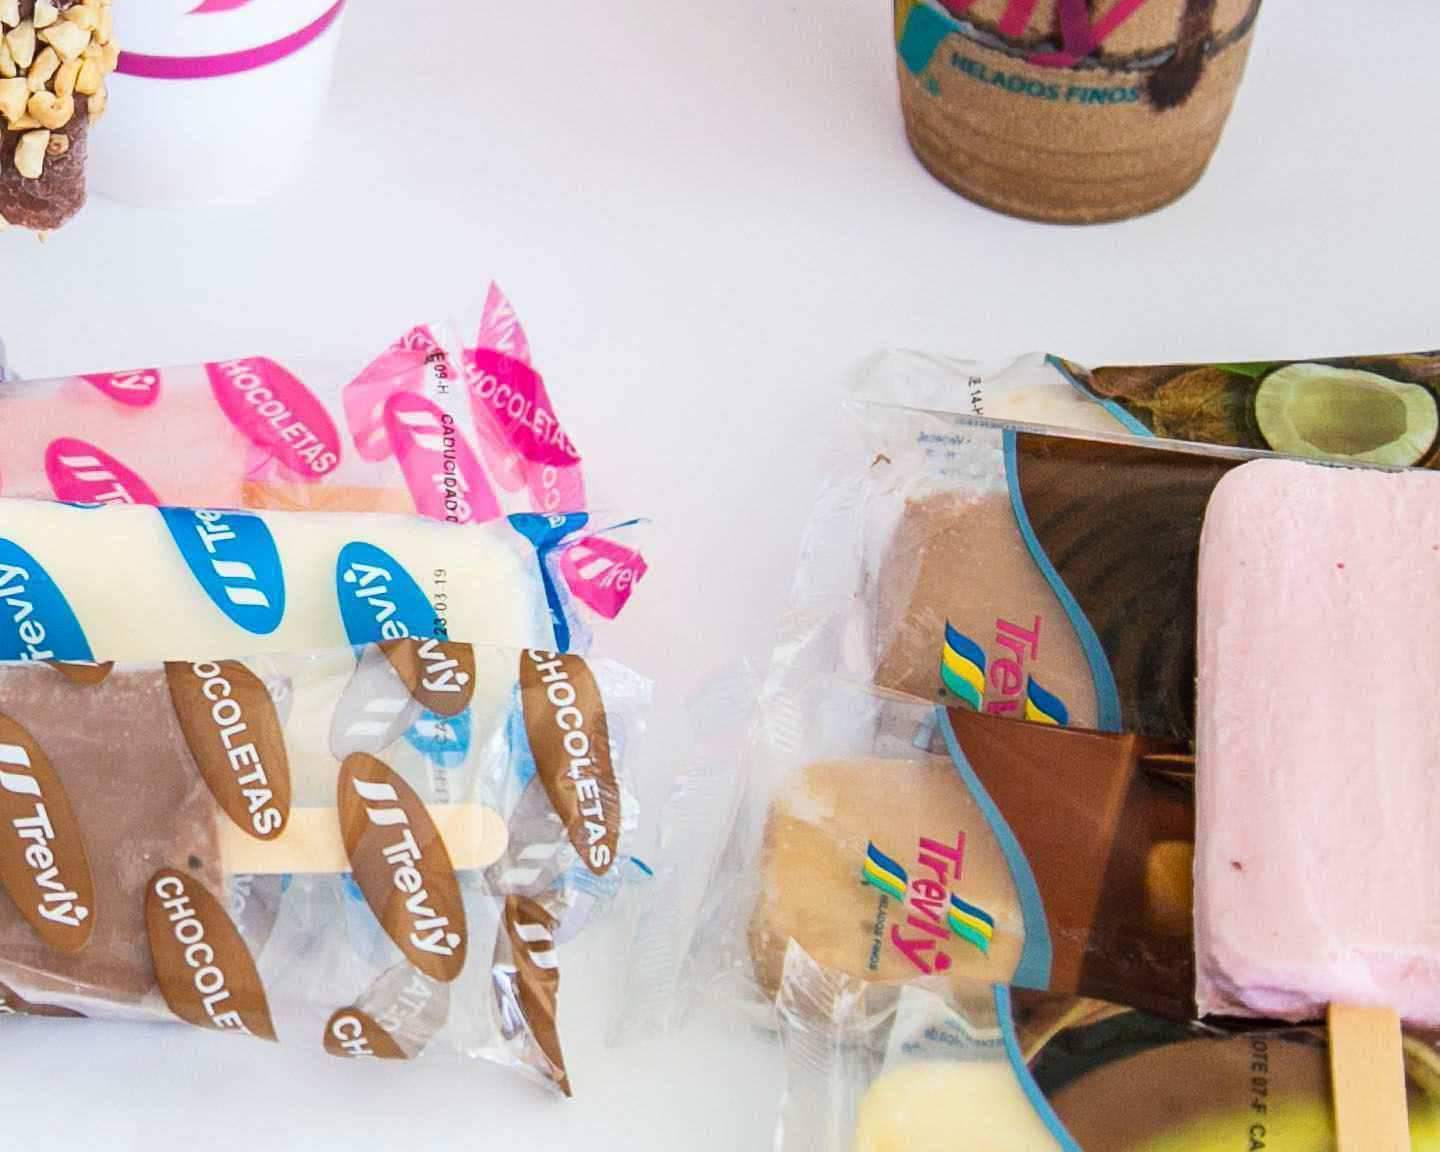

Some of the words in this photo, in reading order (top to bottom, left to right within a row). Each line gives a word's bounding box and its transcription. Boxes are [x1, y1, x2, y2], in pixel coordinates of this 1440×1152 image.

[949, 51, 1061, 104] HELADOS
[1064, 84, 1140, 106] FINOS
[194, 509, 238, 554] Tre
[343, 561, 410, 640] evly
[528, 647, 612, 869] CHOCOLETAS
[11, 802, 89, 927] Trevly
[382, 828, 461, 957] Trevly
[891, 830, 966, 975] Trevly
[154, 876, 250, 1035] CHOCOLE
[1250, 1039, 1269, 1073] OTE
